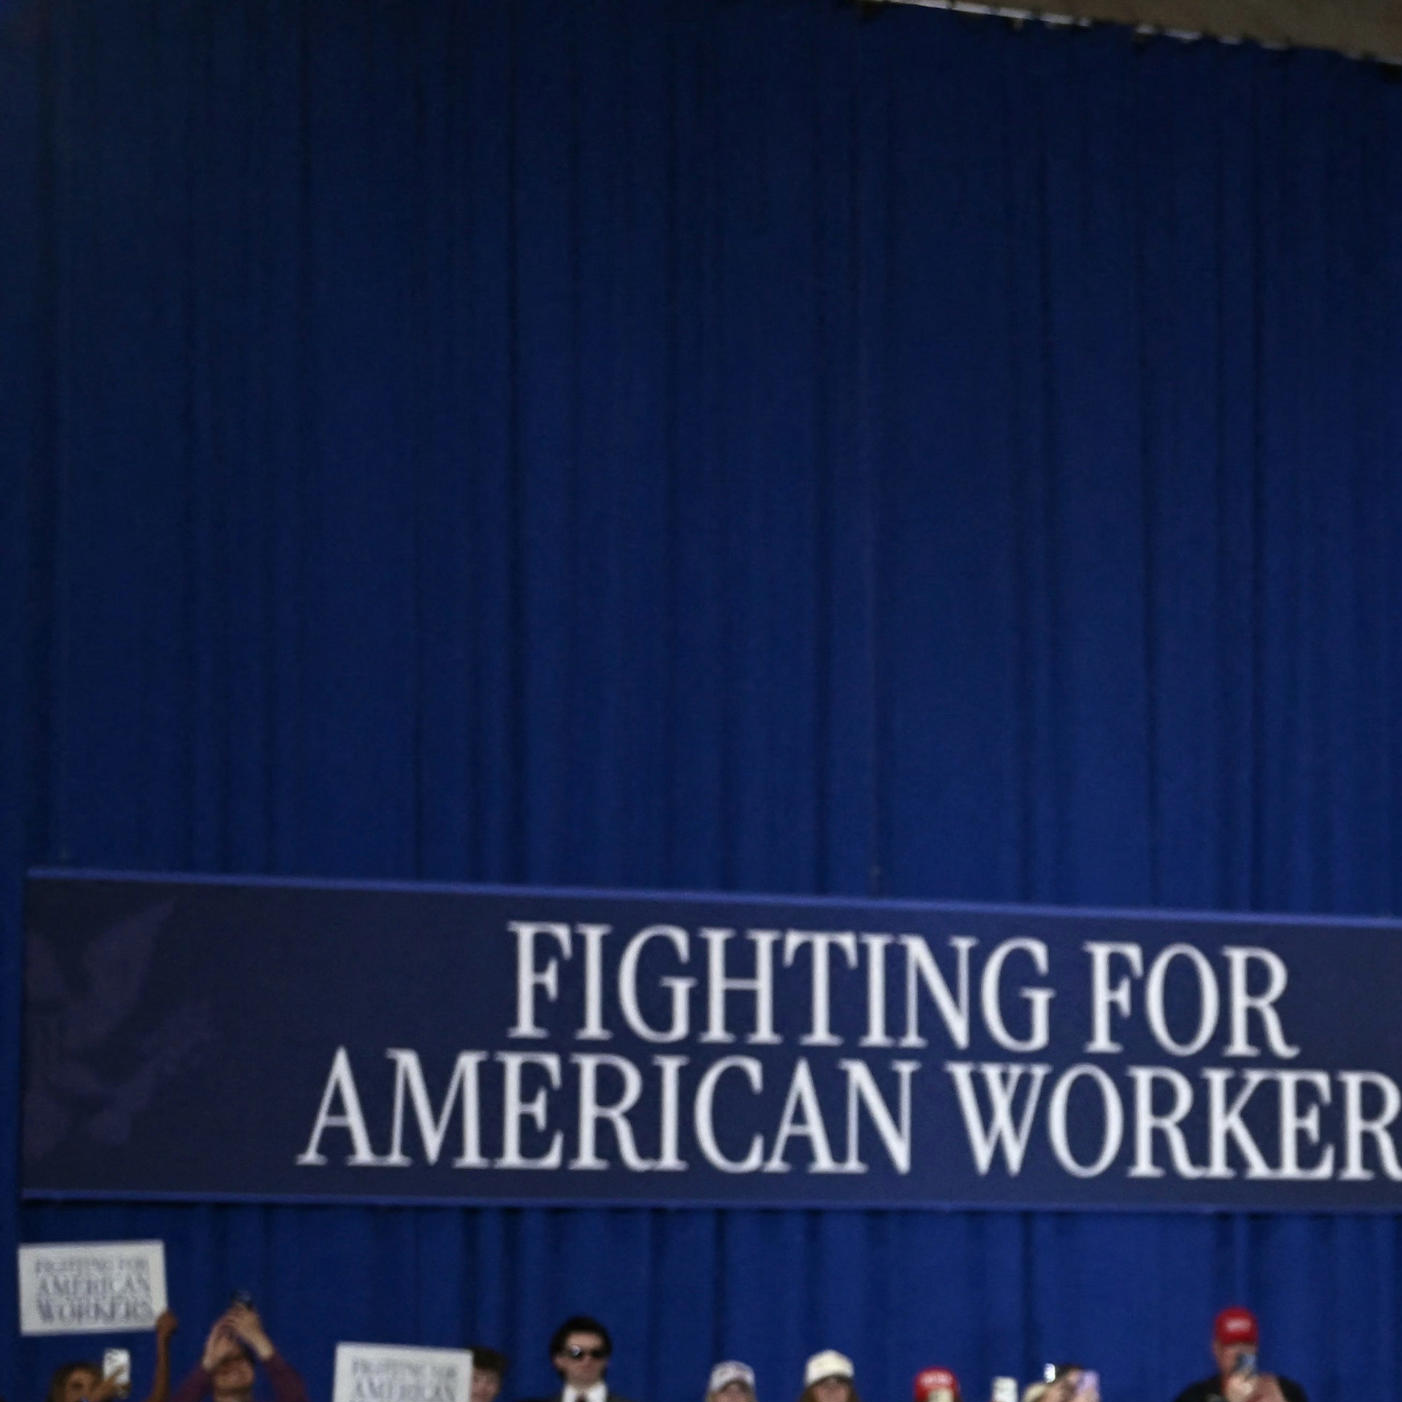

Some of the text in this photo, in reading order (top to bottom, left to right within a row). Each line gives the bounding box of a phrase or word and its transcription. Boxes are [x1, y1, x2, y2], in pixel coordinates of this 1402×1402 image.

[507, 919, 1302, 1061] FIGHTING FOR
[296, 1045, 922, 1176] AMERICAN
